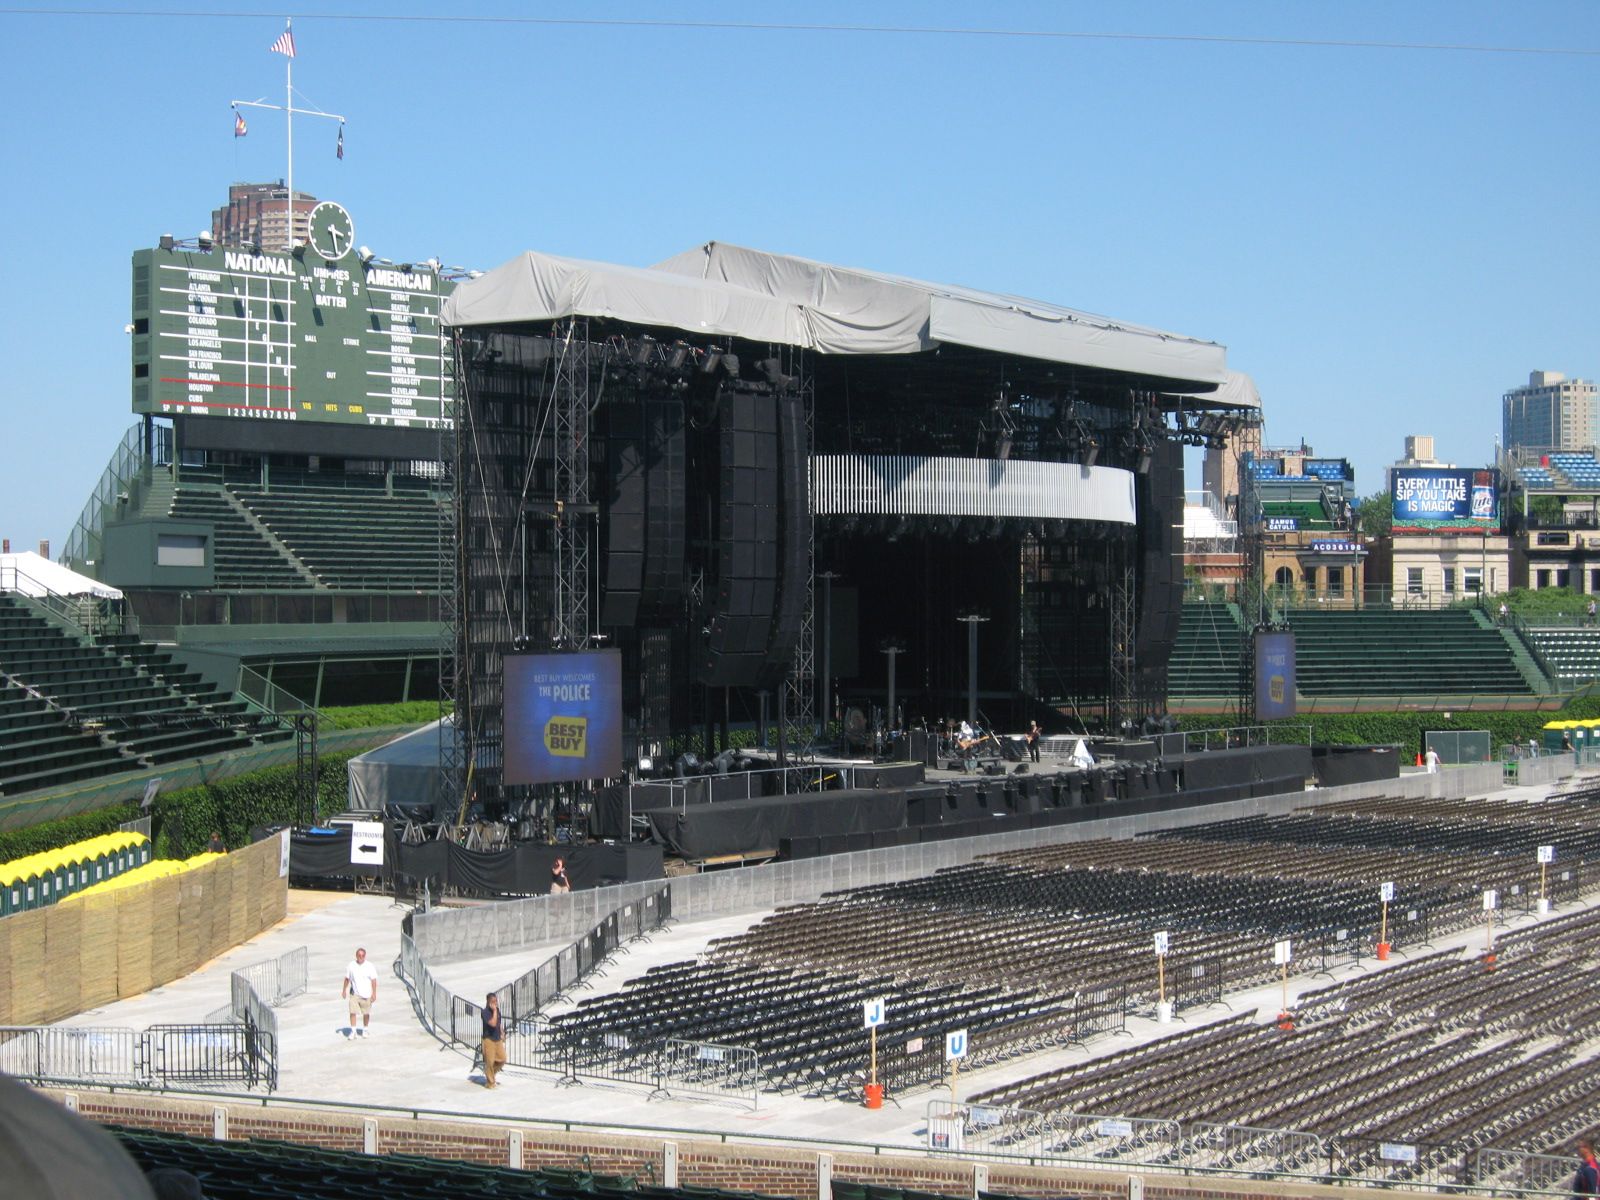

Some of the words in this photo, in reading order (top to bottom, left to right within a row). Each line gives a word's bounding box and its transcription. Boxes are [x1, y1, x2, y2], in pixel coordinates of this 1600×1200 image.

[225, 251, 296, 276] NATIONAL
[188, 271, 220, 282] PITTSBURGH
[313, 267, 349, 281] UMPIRES
[366, 269, 432, 291] AMERICAN
[189, 283, 211, 292] ATLANTA
[315, 294, 347, 309] BATTER
[188, 315, 217, 326] COLORADO
[188, 327, 219, 337] MILWAUKEE
[304, 334, 317, 342] BALL
[343, 338, 360, 346] STRIKE
[188, 339, 198, 347] LOS
[198, 340, 222, 349] ANGELES
[188, 349, 198, 358] SAN
[198, 351, 222, 360] FRANCISCO
[197, 362, 213, 370] LOUIS
[188, 372, 220, 382] PHILADELPHIA
[326, 371, 336, 379] OUT
[188, 384, 213, 393] HOUSTON
[391, 387, 418, 396] CLEVELAND
[188, 394, 203, 403] CUBS
[391, 398, 412, 406] CHICAGO
[325, 403, 338, 412] HITS
[234, 408, 239, 417] 2
[241, 408, 246, 417] 3
[248, 408, 253, 418] 4
[255, 409, 261, 418] 5
[262, 409, 268, 418] 6
[269, 410, 275, 419] 7
[276, 411, 282, 419] 8
[283, 411, 289, 419] 9
[1397, 478, 1431, 489] EVERY
[1433, 478, 1466, 489] LITTLE
[1396, 490, 1413, 500] SIP
[1417, 490, 1438, 500] YOU
[1438, 490, 1467, 501] TAKE
[1408, 500, 1418, 511] IS
[1421, 501, 1455, 511] MAGIC
[534, 673, 548, 683] BEST
[539, 686, 551, 697] THE
[553, 684, 591, 702] POLICE
[549, 723, 585, 738] BEST
[550, 736, 581, 751] BUY
[870, 1005, 880, 1022] J
[951, 1035, 963, 1055] U
